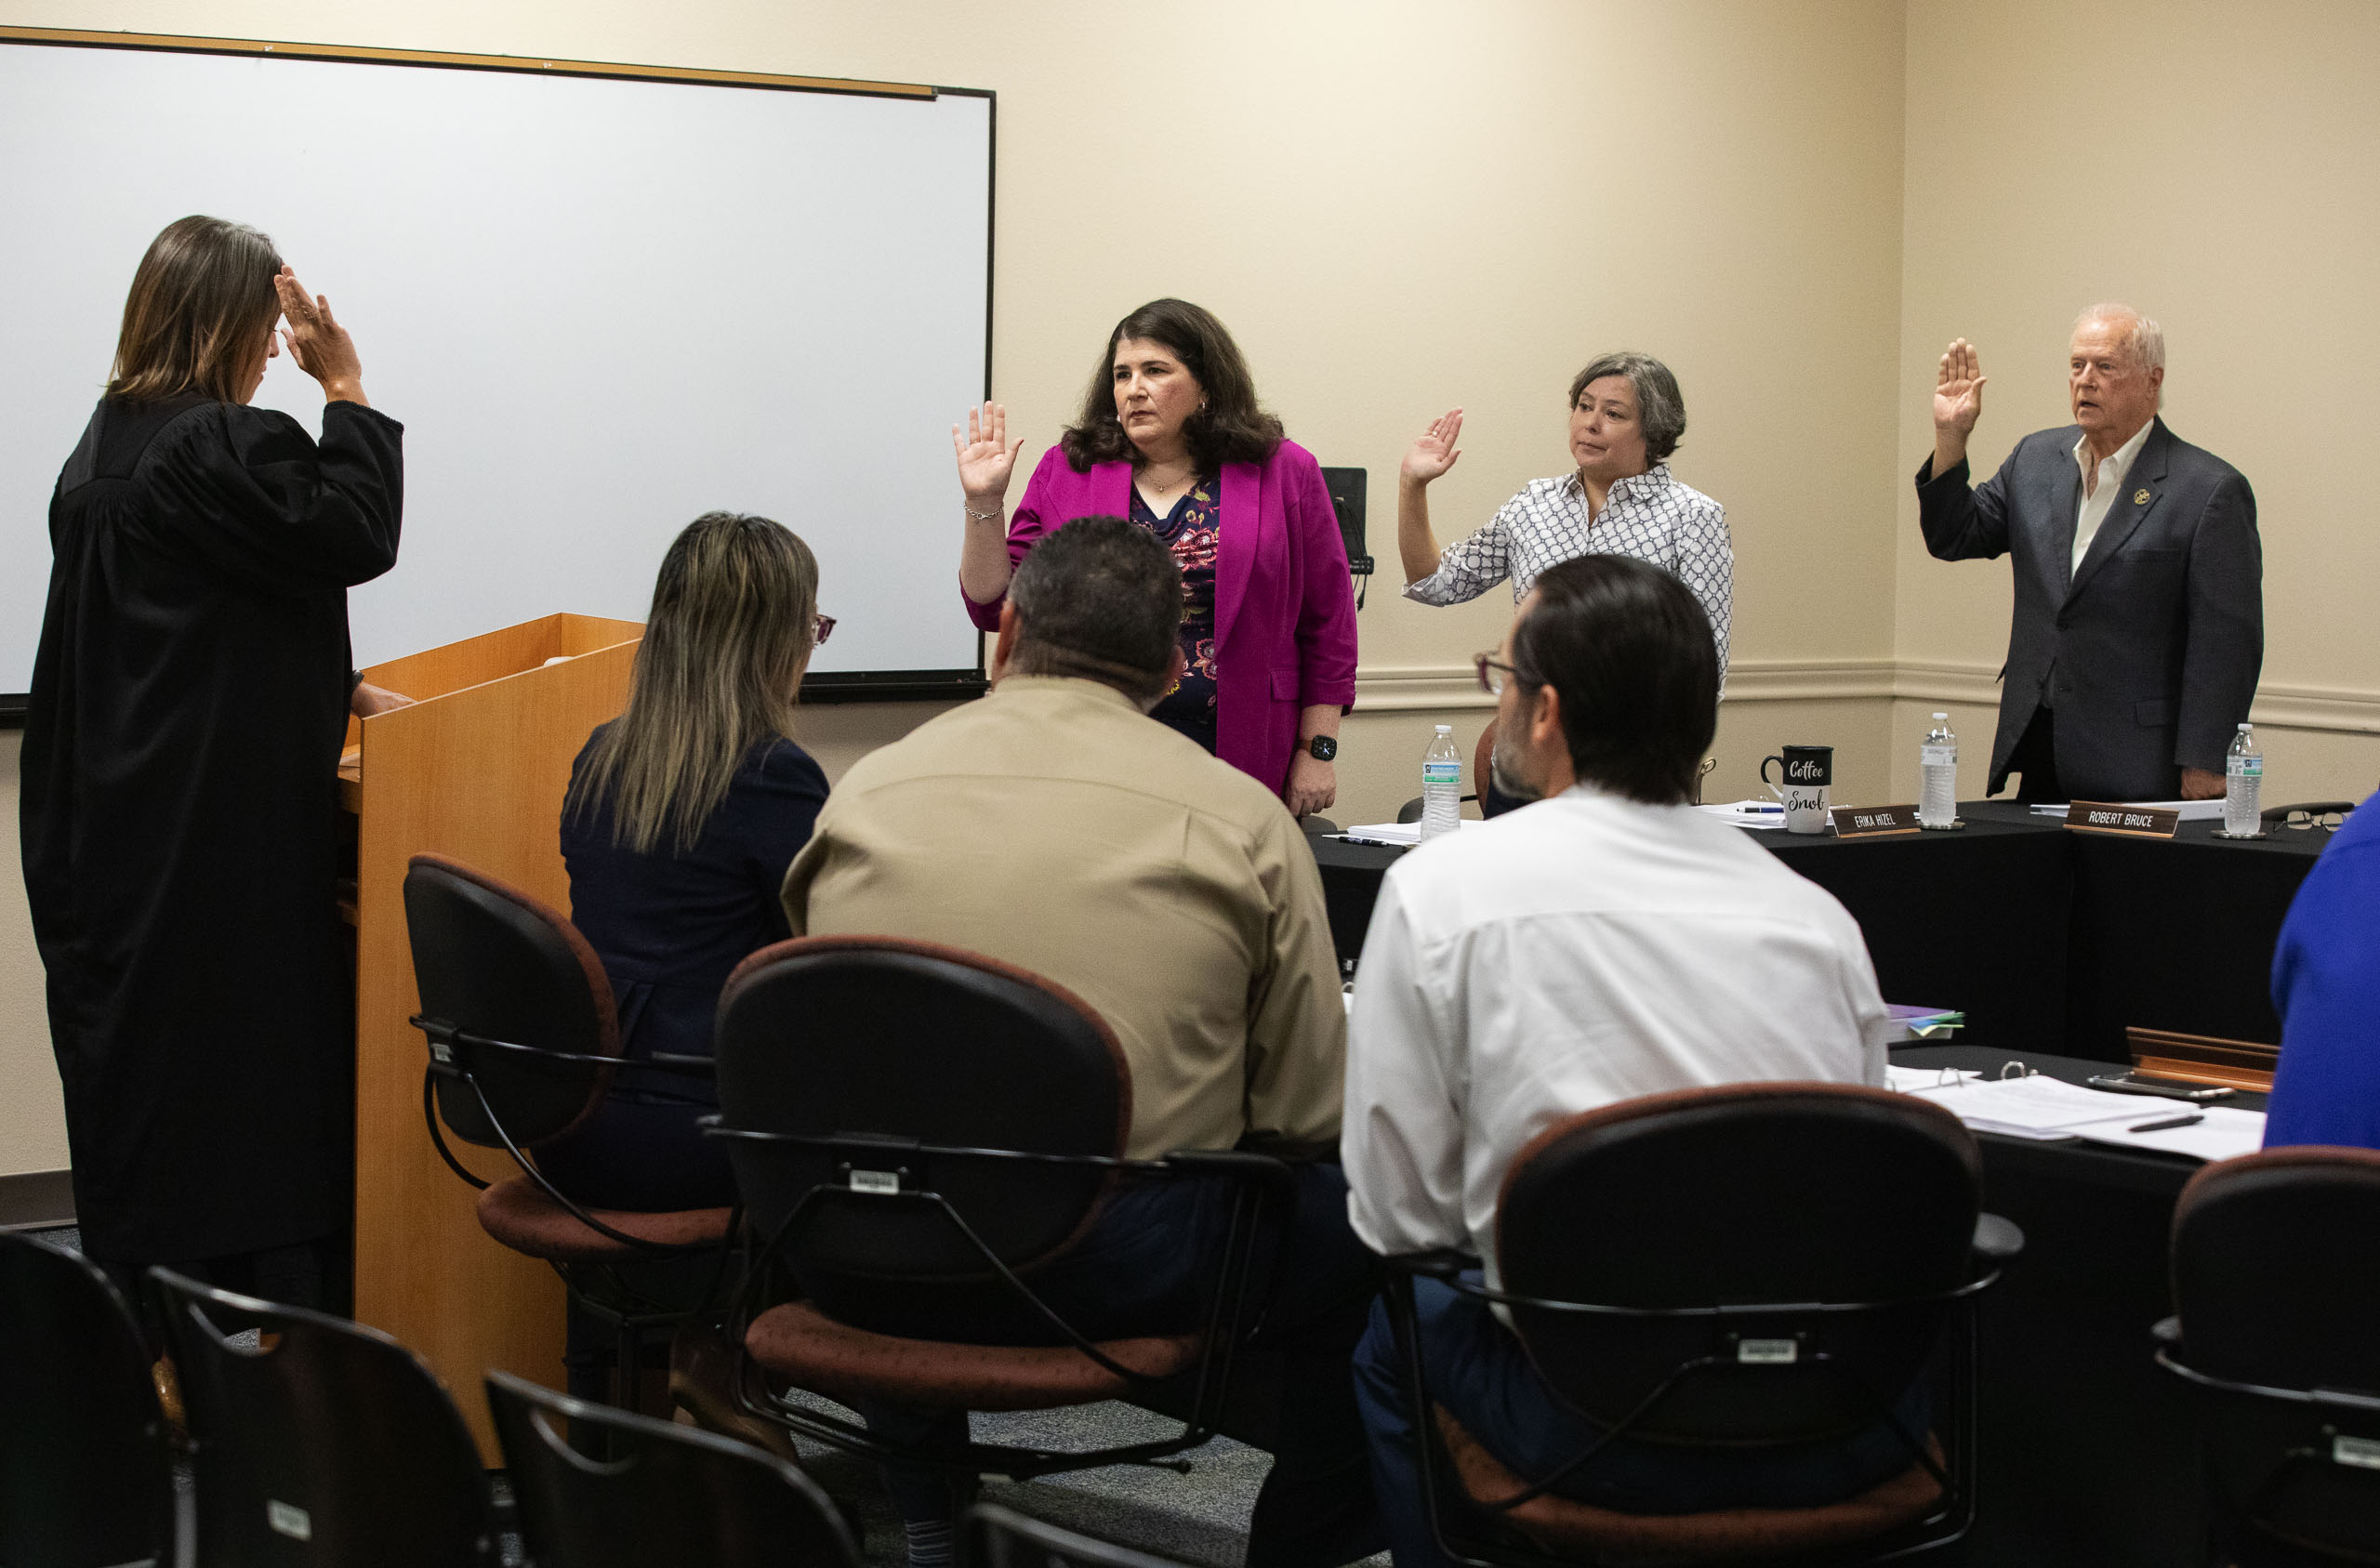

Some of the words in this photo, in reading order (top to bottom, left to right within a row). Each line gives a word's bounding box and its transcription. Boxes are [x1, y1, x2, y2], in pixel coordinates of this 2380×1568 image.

[1789, 760, 1824, 780] Coffee
[1788, 789, 1825, 811] Snob
[1854, 814, 1875, 828] ERIKA
[1875, 813, 1897, 826] HIZEL
[2088, 810, 2123, 824] ROBERT
[2123, 813, 2153, 827] BRUCE
